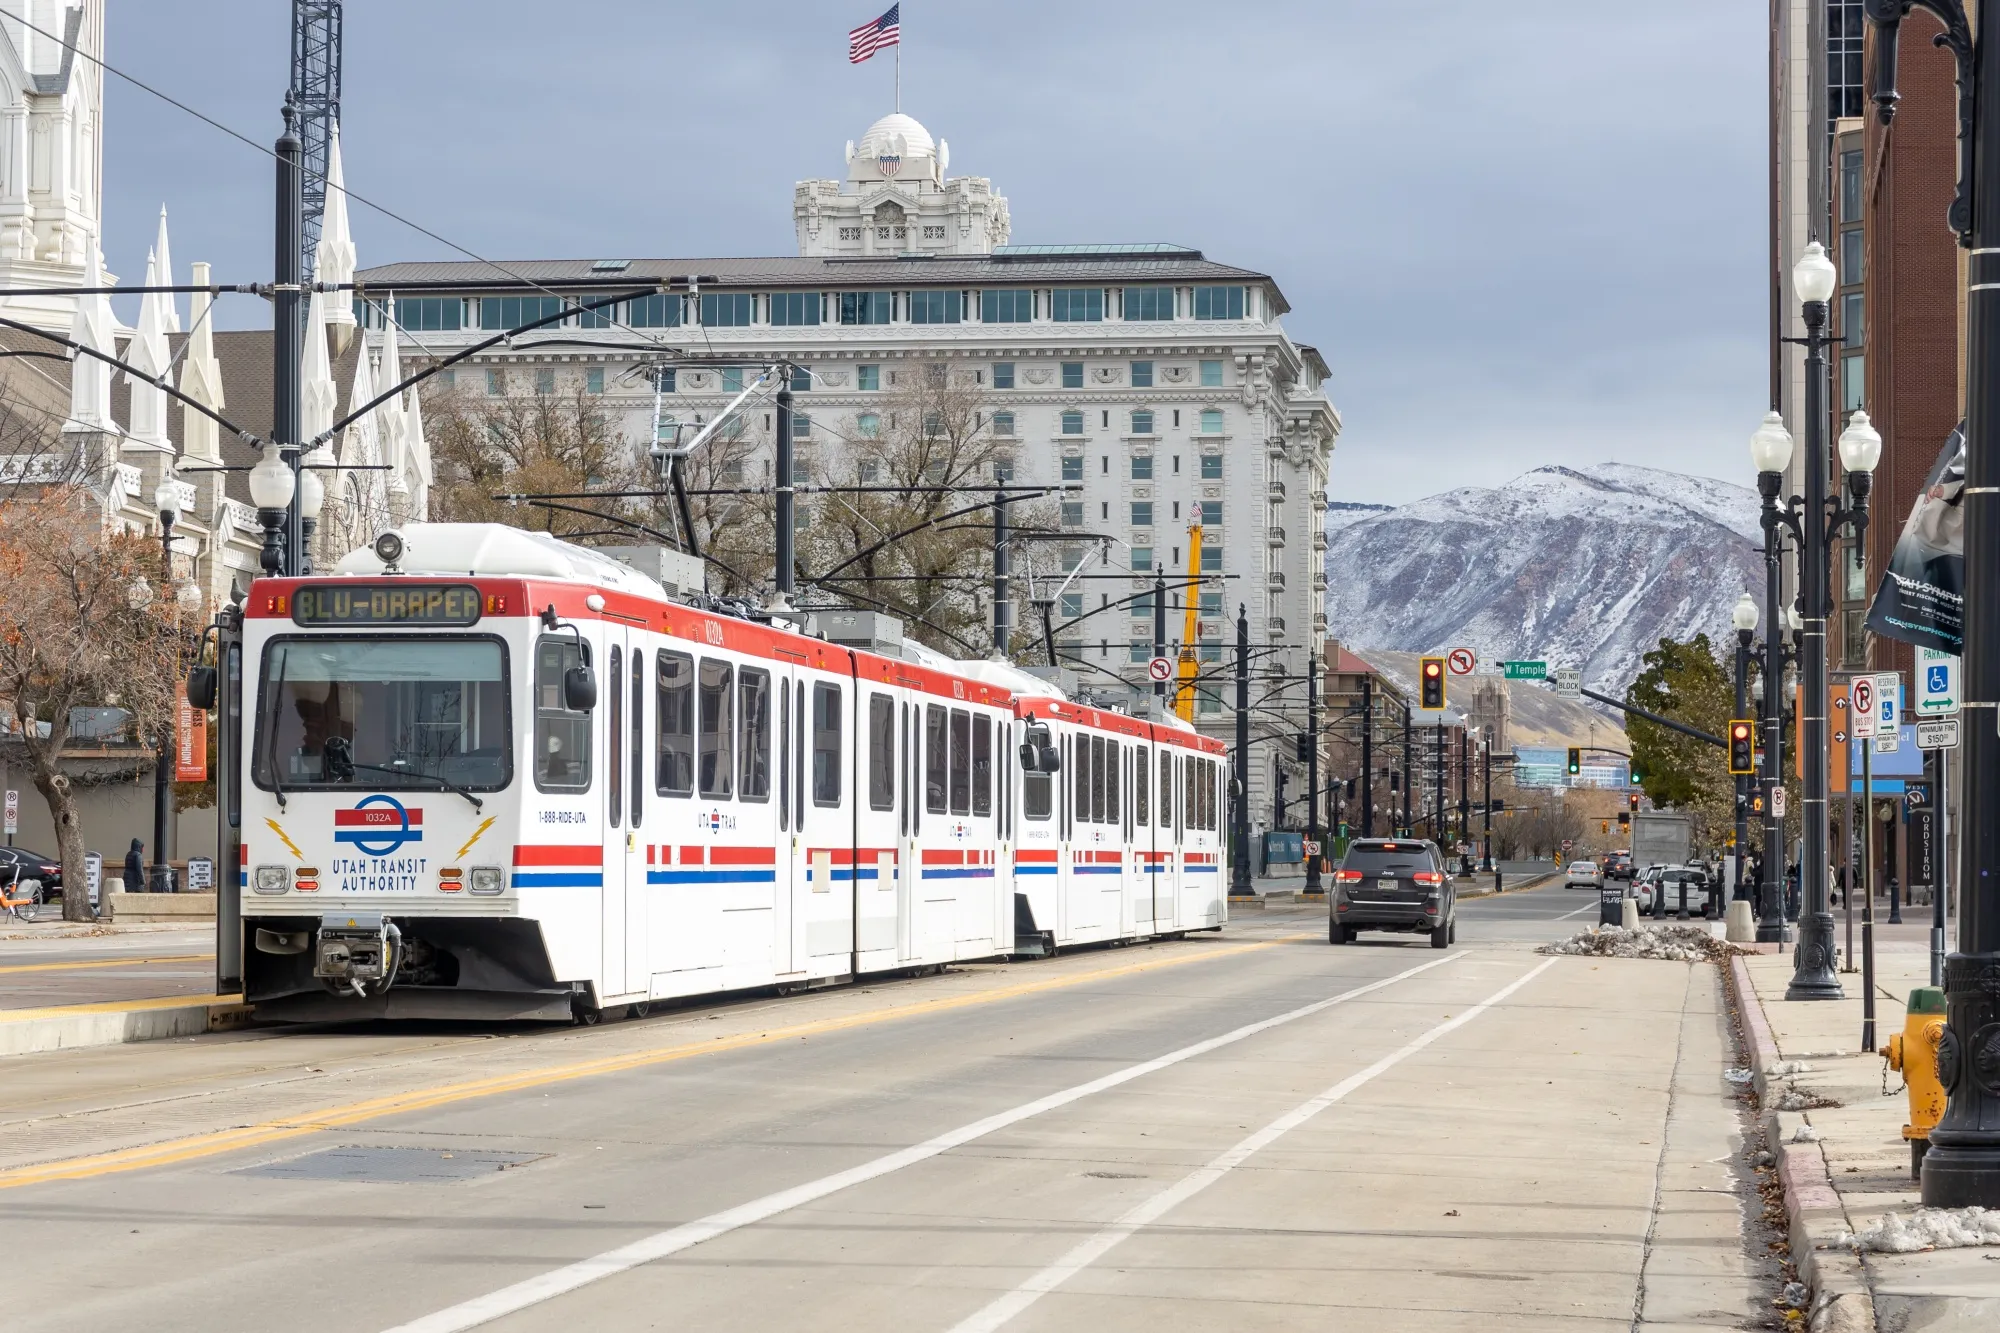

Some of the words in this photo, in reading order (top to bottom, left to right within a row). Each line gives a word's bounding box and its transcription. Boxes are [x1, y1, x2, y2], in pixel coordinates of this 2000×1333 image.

[1922, 582, 1963, 604] SYMPH
[301, 591, 478, 618] BLU-DRAPER
[704, 618, 725, 646] 1032A
[1505, 665, 1511, 674] W
[1515, 665, 1546, 675] Temple
[1559, 682, 1579, 690] BLOCK
[1878, 677, 1896, 687] RESERVED
[1879, 688, 1895, 697] PARKING
[181, 710, 191, 728] UTAH
[193, 709, 202, 728] NESS
[1855, 717, 1863, 727] BUS
[1864, 716, 1873, 726] STOP
[1920, 725, 1943, 733] MINIMUM
[181, 728, 191, 765] SYMPHONY
[365, 813, 392, 822] 1032A
[539, 811, 586, 824] 1-888-RIDE-UTA
[721, 814, 737, 831] TRAX
[1922, 815, 1930, 880] ORDSTROM
[333, 859, 366, 874] UTAH
[371, 859, 427, 874] TRANSIT
[341, 876, 417, 891] AUTHORITY
